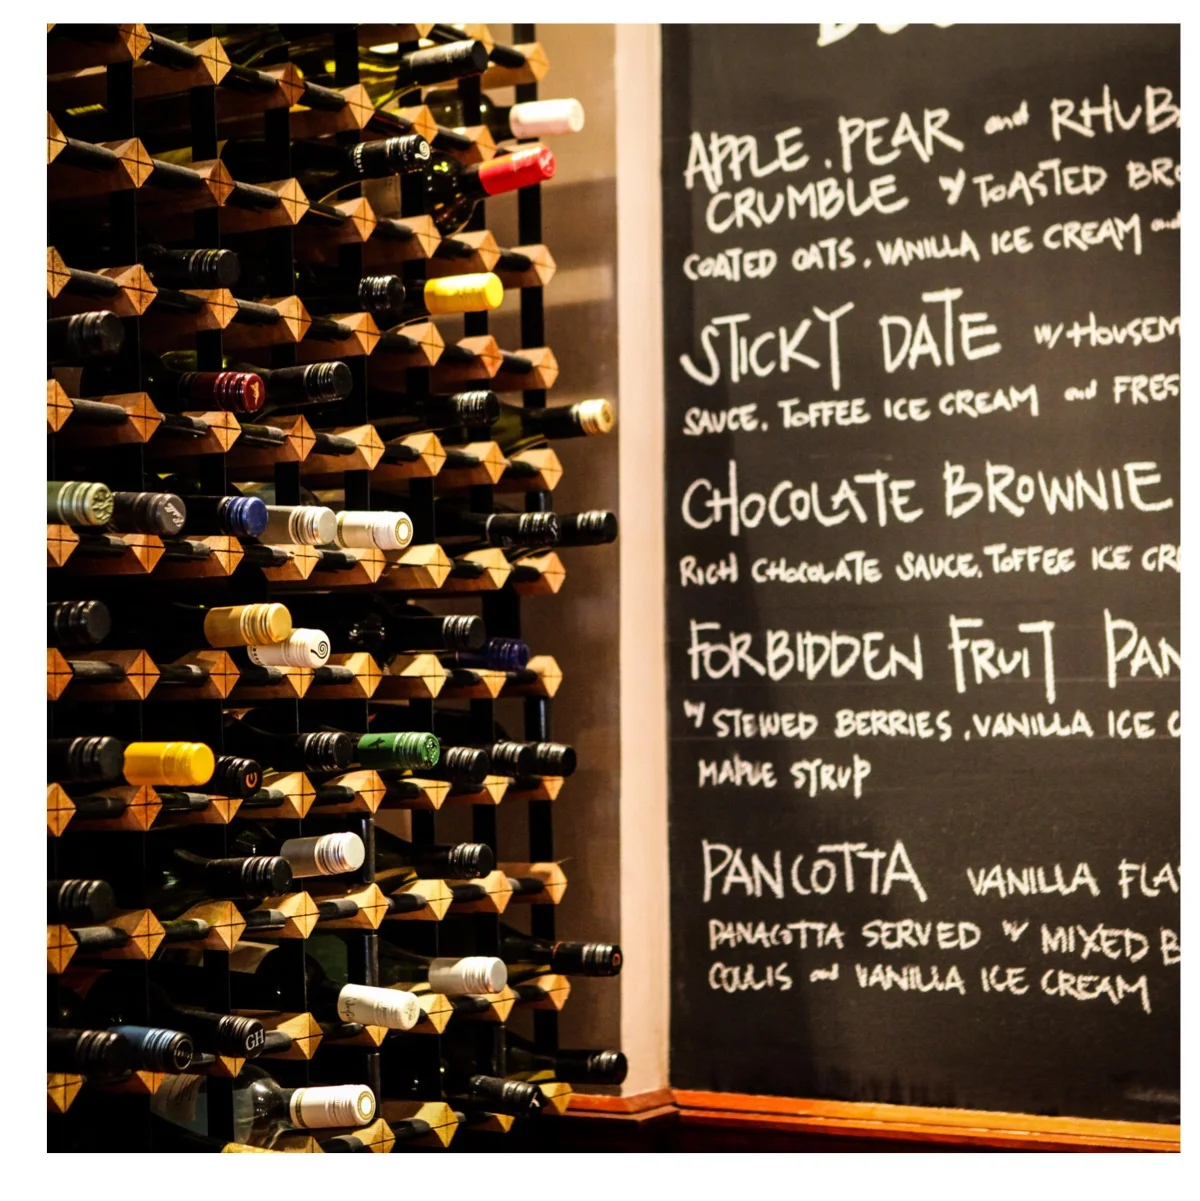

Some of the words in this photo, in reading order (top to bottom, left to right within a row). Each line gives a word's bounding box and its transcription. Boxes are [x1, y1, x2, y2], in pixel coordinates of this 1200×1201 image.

[984, 101, 1029, 135] and
[1051, 85, 1180, 141] RHUB
[706, 174, 910, 234] CRUMBLE
[973, 159, 1108, 208] TOASTED
[684, 247, 777, 282] COATED
[877, 231, 980, 267] VANILLA
[992, 227, 1033, 255] ICE
[1042, 212, 1143, 256] CREAM
[679, 301, 855, 391] STICKY
[879, 288, 1002, 373] DATE
[777, 398, 872, 429] TOFFEE
[884, 398, 932, 422] ICE
[939, 384, 1039, 416] CREAM
[1064, 379, 1098, 401] and
[1113, 374, 1180, 405] FRES
[681, 459, 924, 536] CHOCOLATE
[943, 459, 1174, 518] BROWNIE
[680, 552, 740, 586] RICH
[751, 550, 884, 584] CHOCOLATE
[984, 543, 1076, 574] TOFFEE
[1091, 543, 1132, 571] ICE
[687, 618, 924, 682] FORBIDDEN
[948, 614, 1055, 705] FRUIT
[716, 709, 819, 739] STEWED
[1108, 711, 1155, 739] ICE
[698, 754, 778, 789] MAPLE
[790, 754, 872, 799] SYRUP
[702, 839, 928, 902] PANCOTTA
[966, 862, 1101, 899] VANILLA
[861, 921, 982, 951] SERVED
[1041, 924, 1150, 964] MIXED
[809, 964, 840, 983] and
[855, 964, 967, 995] VANILLA
[981, 966, 1028, 996] ICE
[1041, 967, 1151, 1014] CREAM
[245, 1031, 266, 1050] GH
